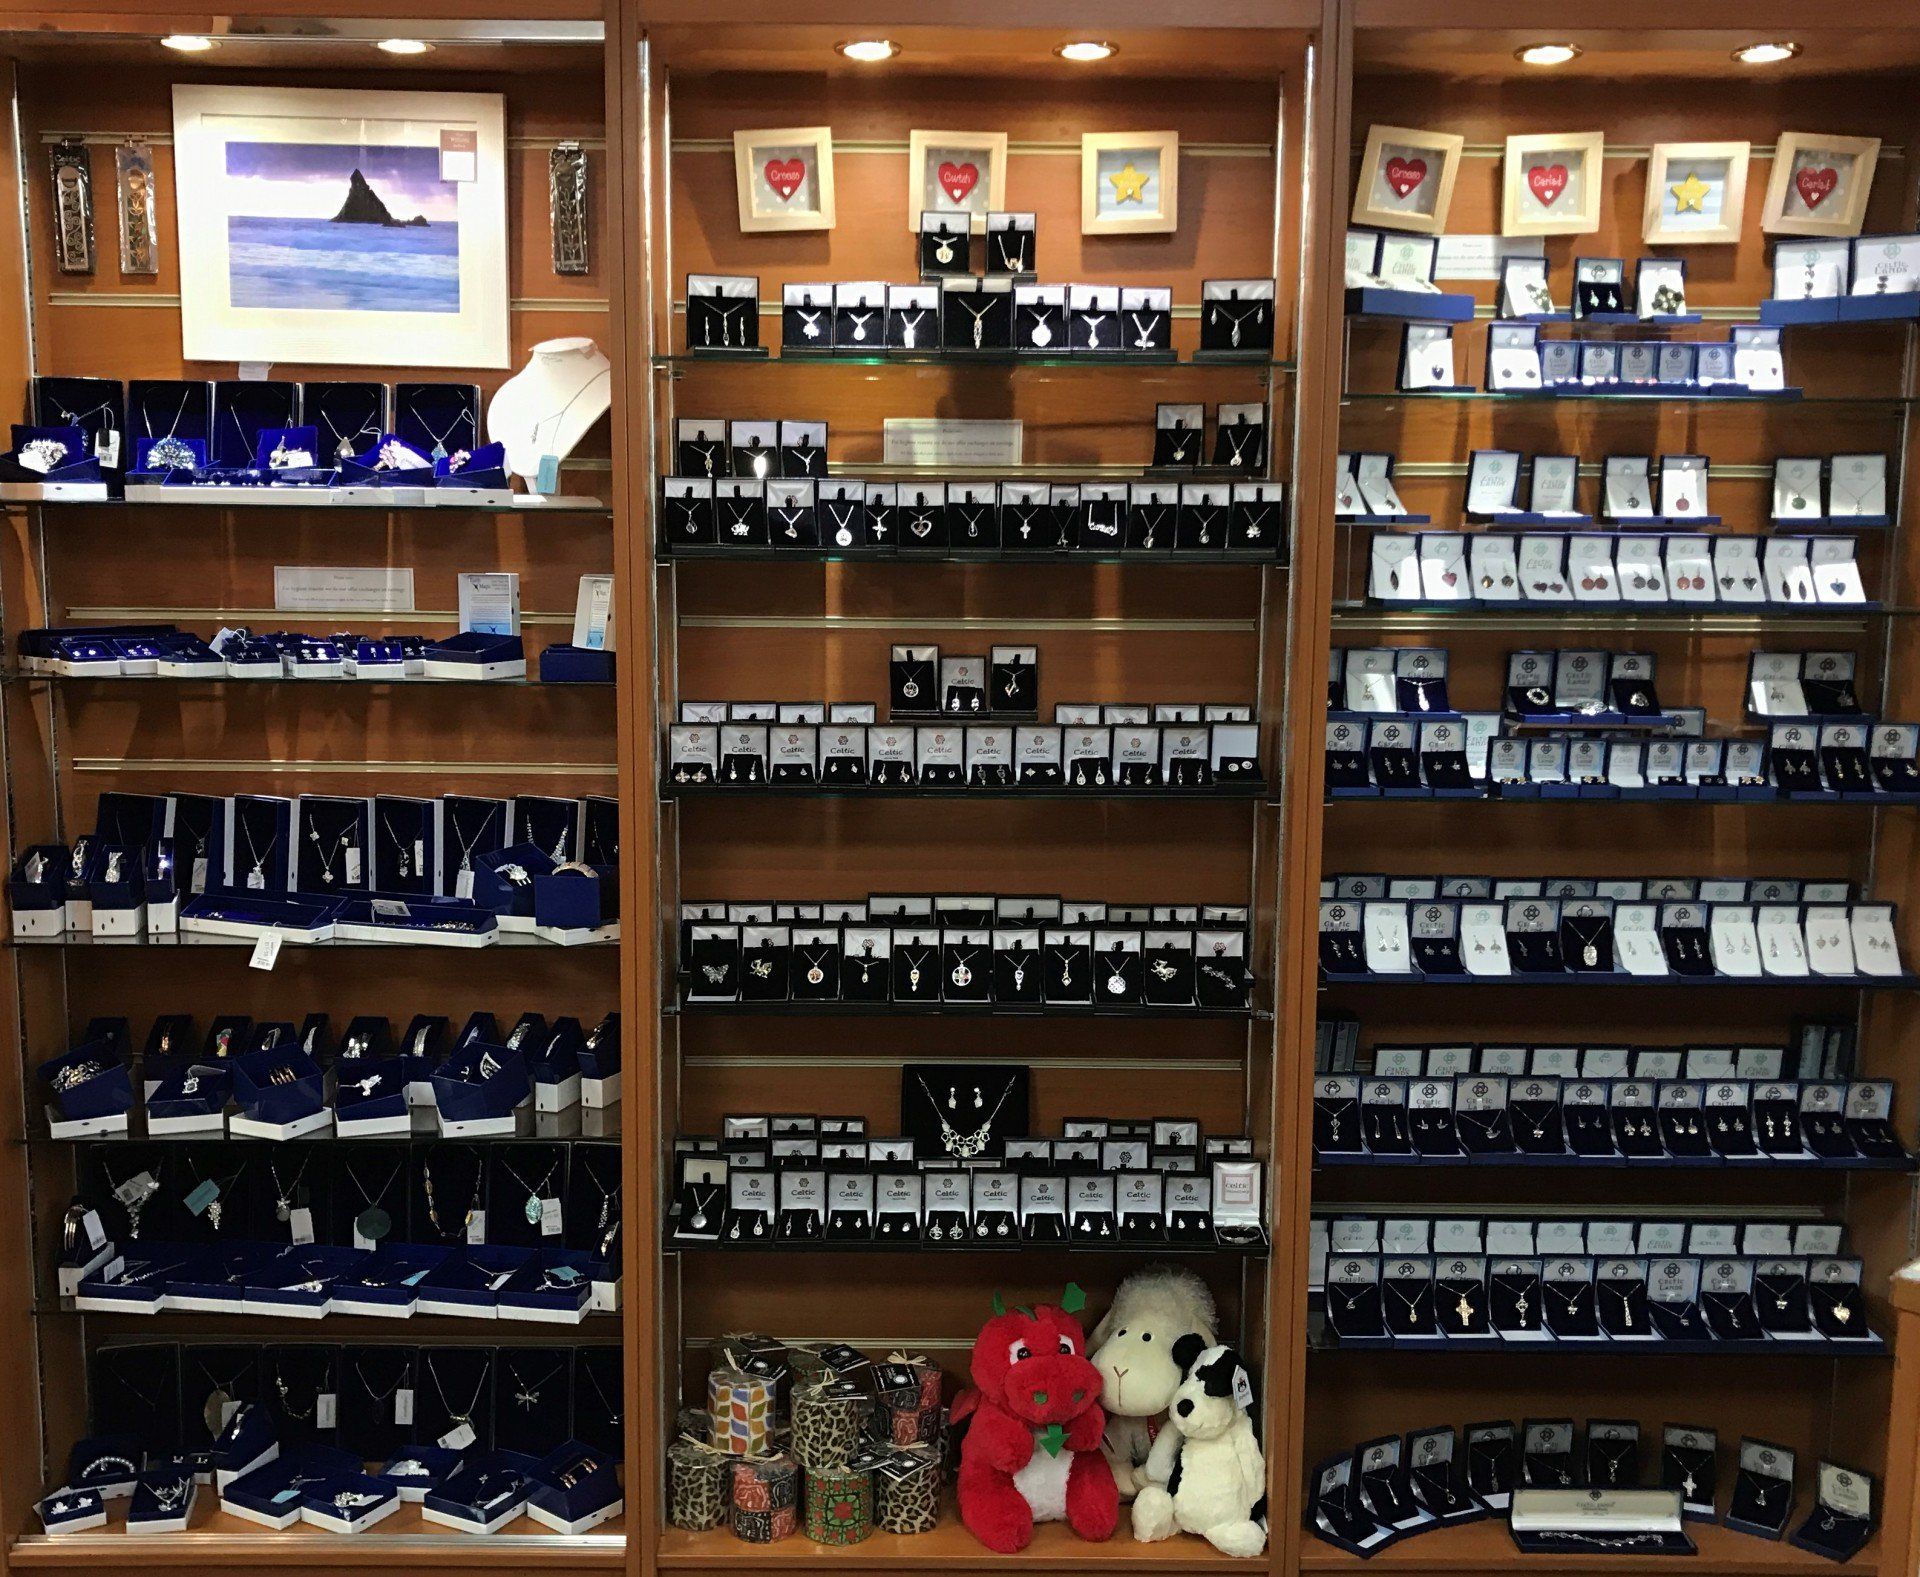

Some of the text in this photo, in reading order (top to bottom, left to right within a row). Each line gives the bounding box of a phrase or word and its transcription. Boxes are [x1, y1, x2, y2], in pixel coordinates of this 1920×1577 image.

[681, 745, 706, 753] Celtic
[732, 745, 756, 753] Celtic
[780, 746, 804, 754] Celtic
[830, 747, 855, 755] Celtic
[878, 749, 903, 757] Celtic
[927, 746, 952, 754] Celtic
[976, 747, 1000, 755] Celtic
[1025, 747, 1050, 755] Celtic
[1073, 748, 1098, 756] Celtic
[1122, 749, 1147, 757] Celtic
[1172, 748, 1196, 756] Celtic
[1126, 1191, 1150, 1199] Celtic
